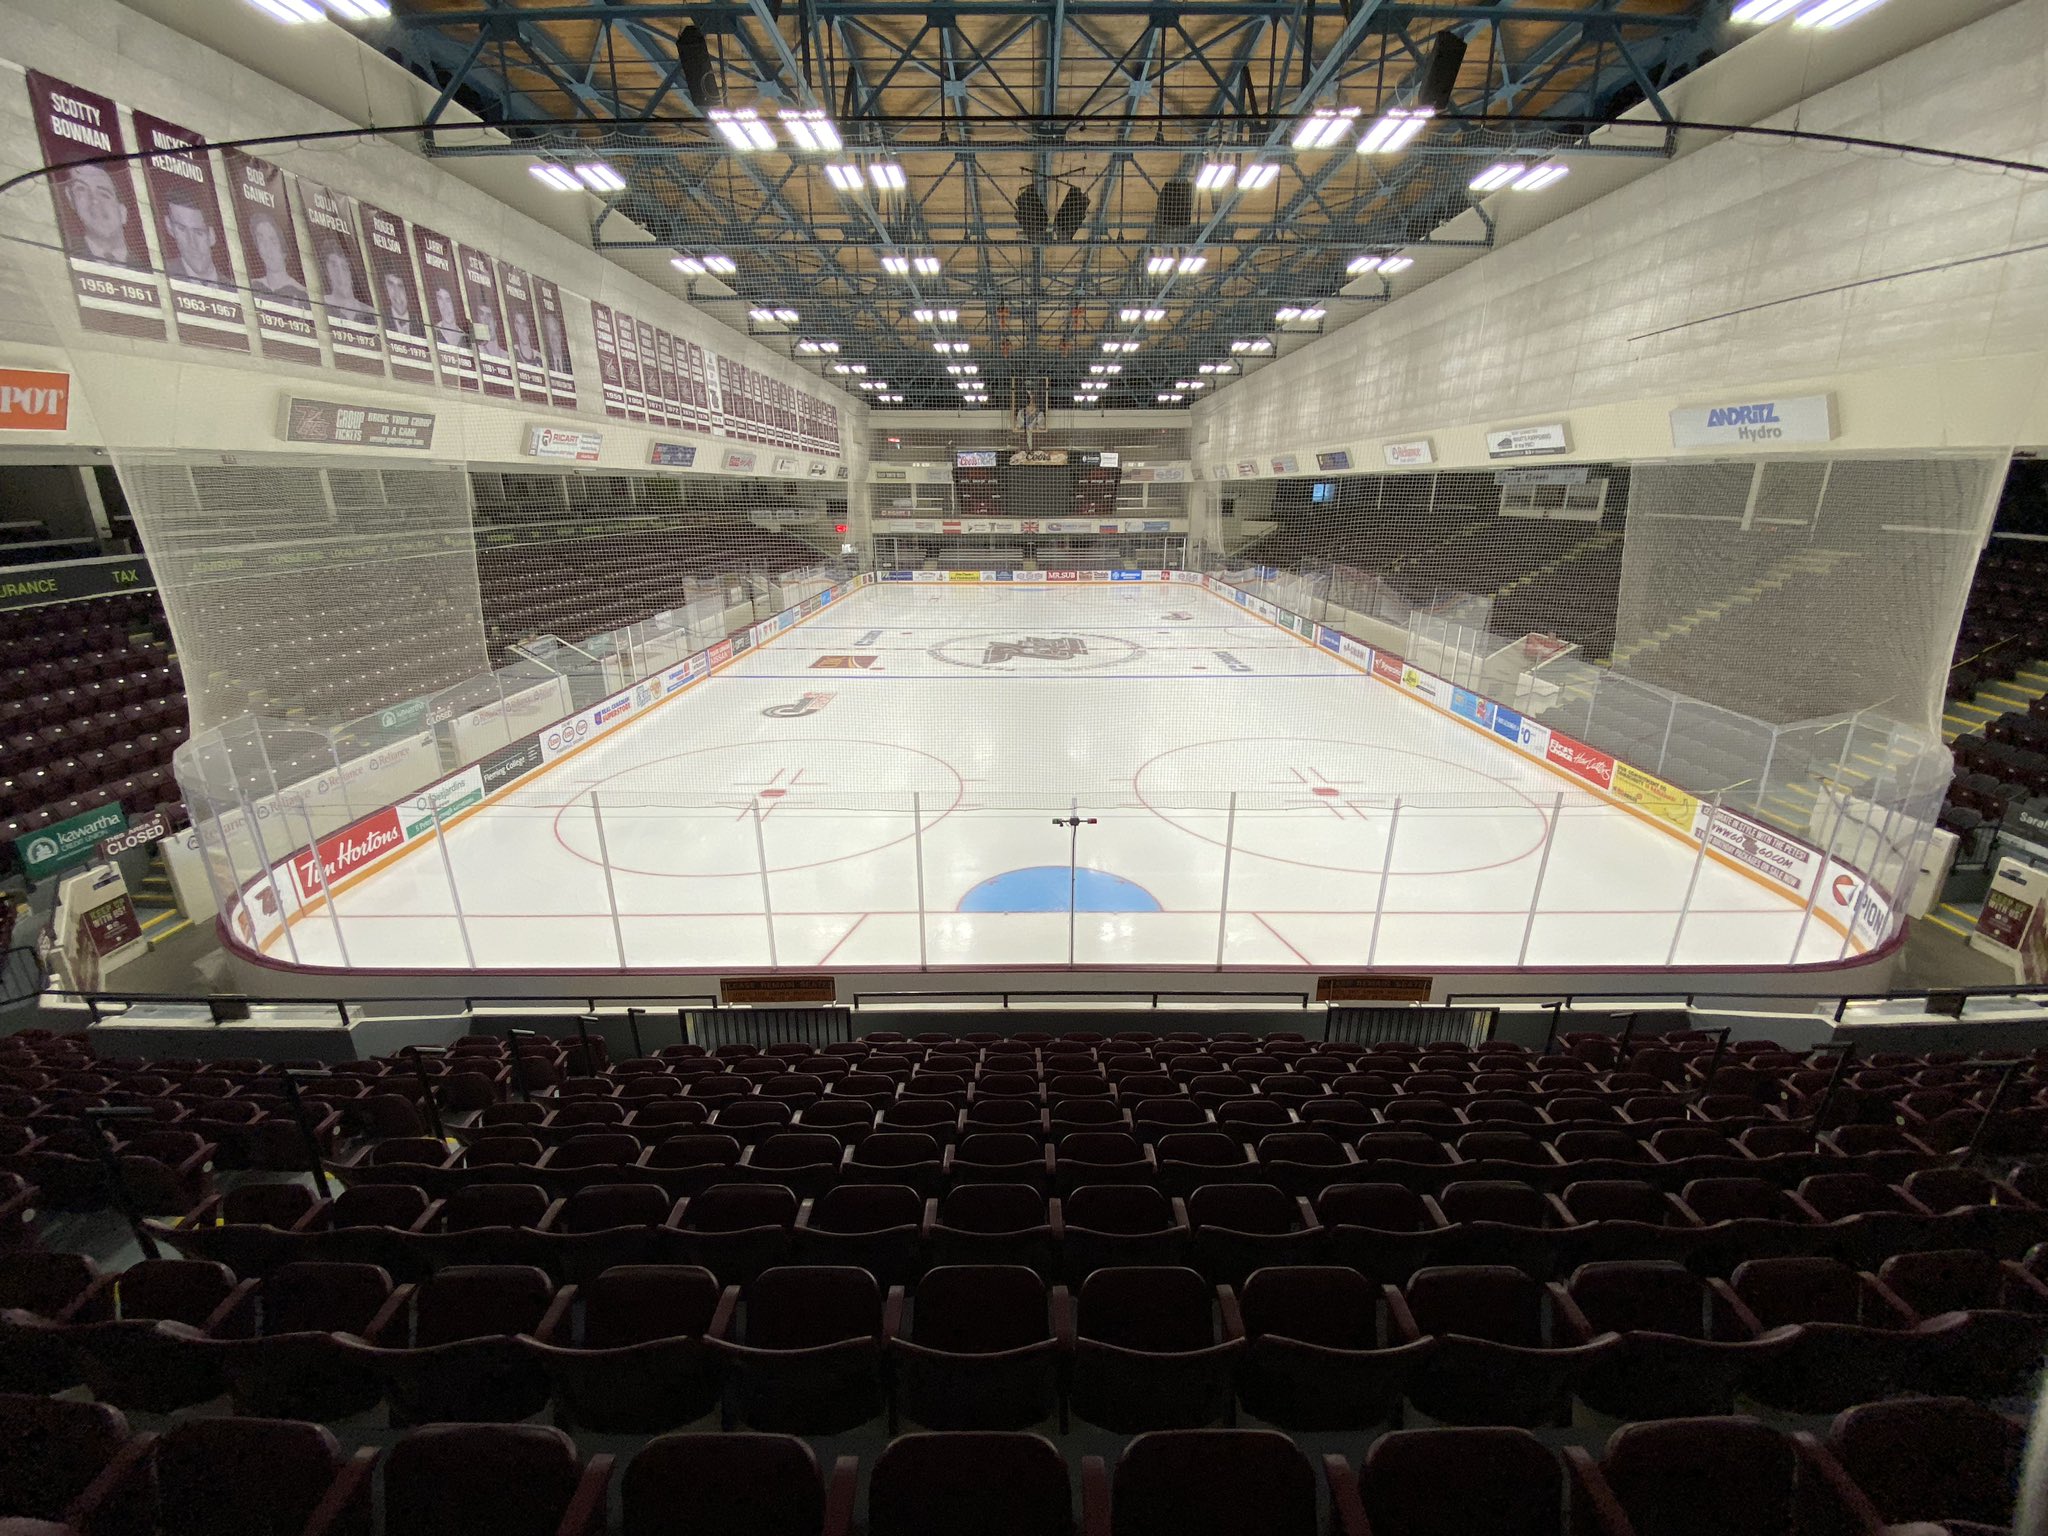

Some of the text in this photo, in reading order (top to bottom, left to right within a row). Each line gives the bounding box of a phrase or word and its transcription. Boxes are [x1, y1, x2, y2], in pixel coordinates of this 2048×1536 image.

[51, 92, 101, 127] SCOTTY
[51, 114, 111, 152] BOWMAN
[151, 155, 204, 183] REDMOND
[246, 166, 266, 187] BOB
[243, 184, 275, 208] GAINEY
[313, 193, 339, 215] COLIN
[308, 208, 350, 235] CAMPBELL
[373, 217, 396, 237] ROGER
[373, 233, 402, 254] NEILSON
[79, 277, 153, 302] 1958-1961
[177, 295, 237, 318] 1963-1967
[260, 313, 311, 334] 1970-1973
[336, 408, 365, 429] GROUP
[335, 428, 363, 441] TICKETS
[553, 432, 579, 444] RICART
[1738, 425, 1782, 442] Hydro
[112, 569, 139, 584] TAX
[484, 766, 506, 783] Fleming
[57, 814, 121, 845] kawartha
[106, 833, 125, 843] THIS
[107, 824, 165, 855] CLOSED
[1738, 822, 1756, 837] STYLE
[300, 826, 399, 888] Tim Hortons
